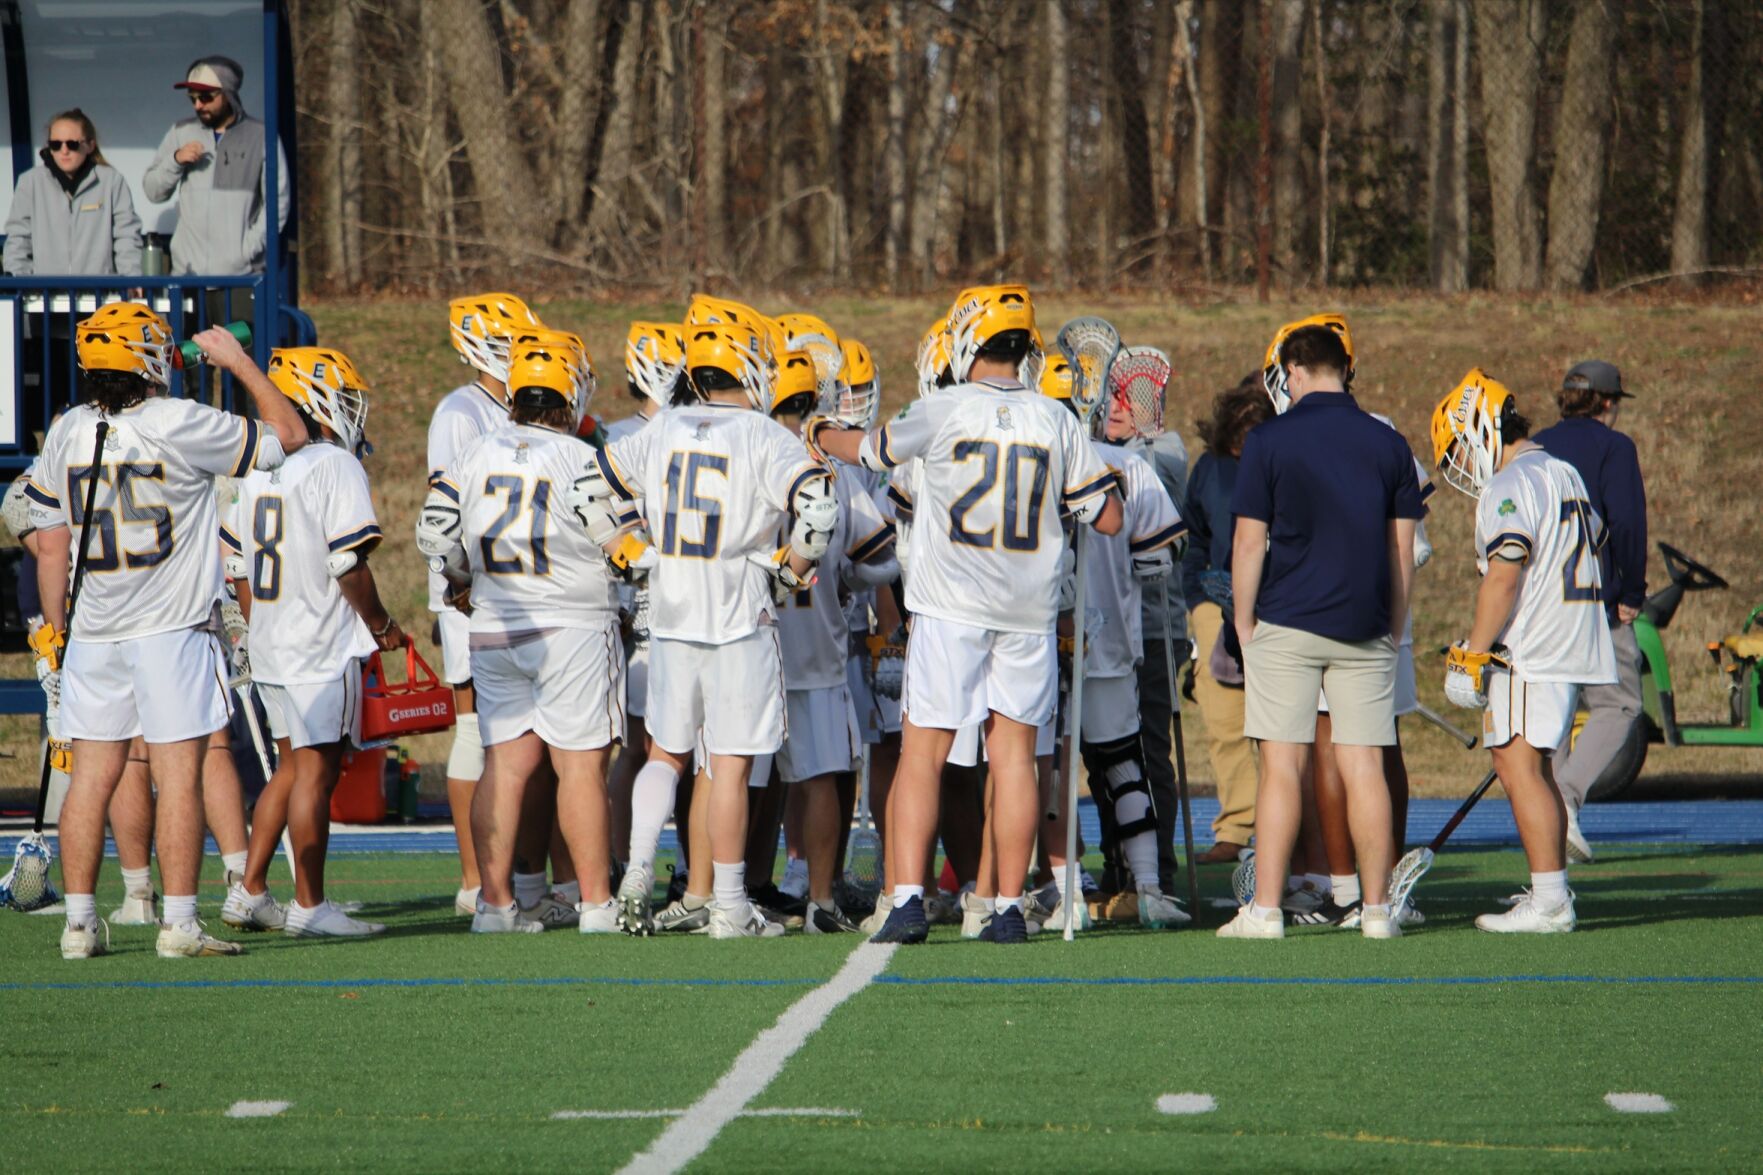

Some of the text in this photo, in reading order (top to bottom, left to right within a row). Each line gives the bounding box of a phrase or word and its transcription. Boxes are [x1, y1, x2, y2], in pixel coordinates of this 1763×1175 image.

[313, 362, 326, 379] E
[251, 495, 284, 602] 8
[479, 474, 553, 577] 21
[660, 449, 732, 561] 15
[949, 439, 1050, 553] 20
[1448, 663, 1467, 674] STX
